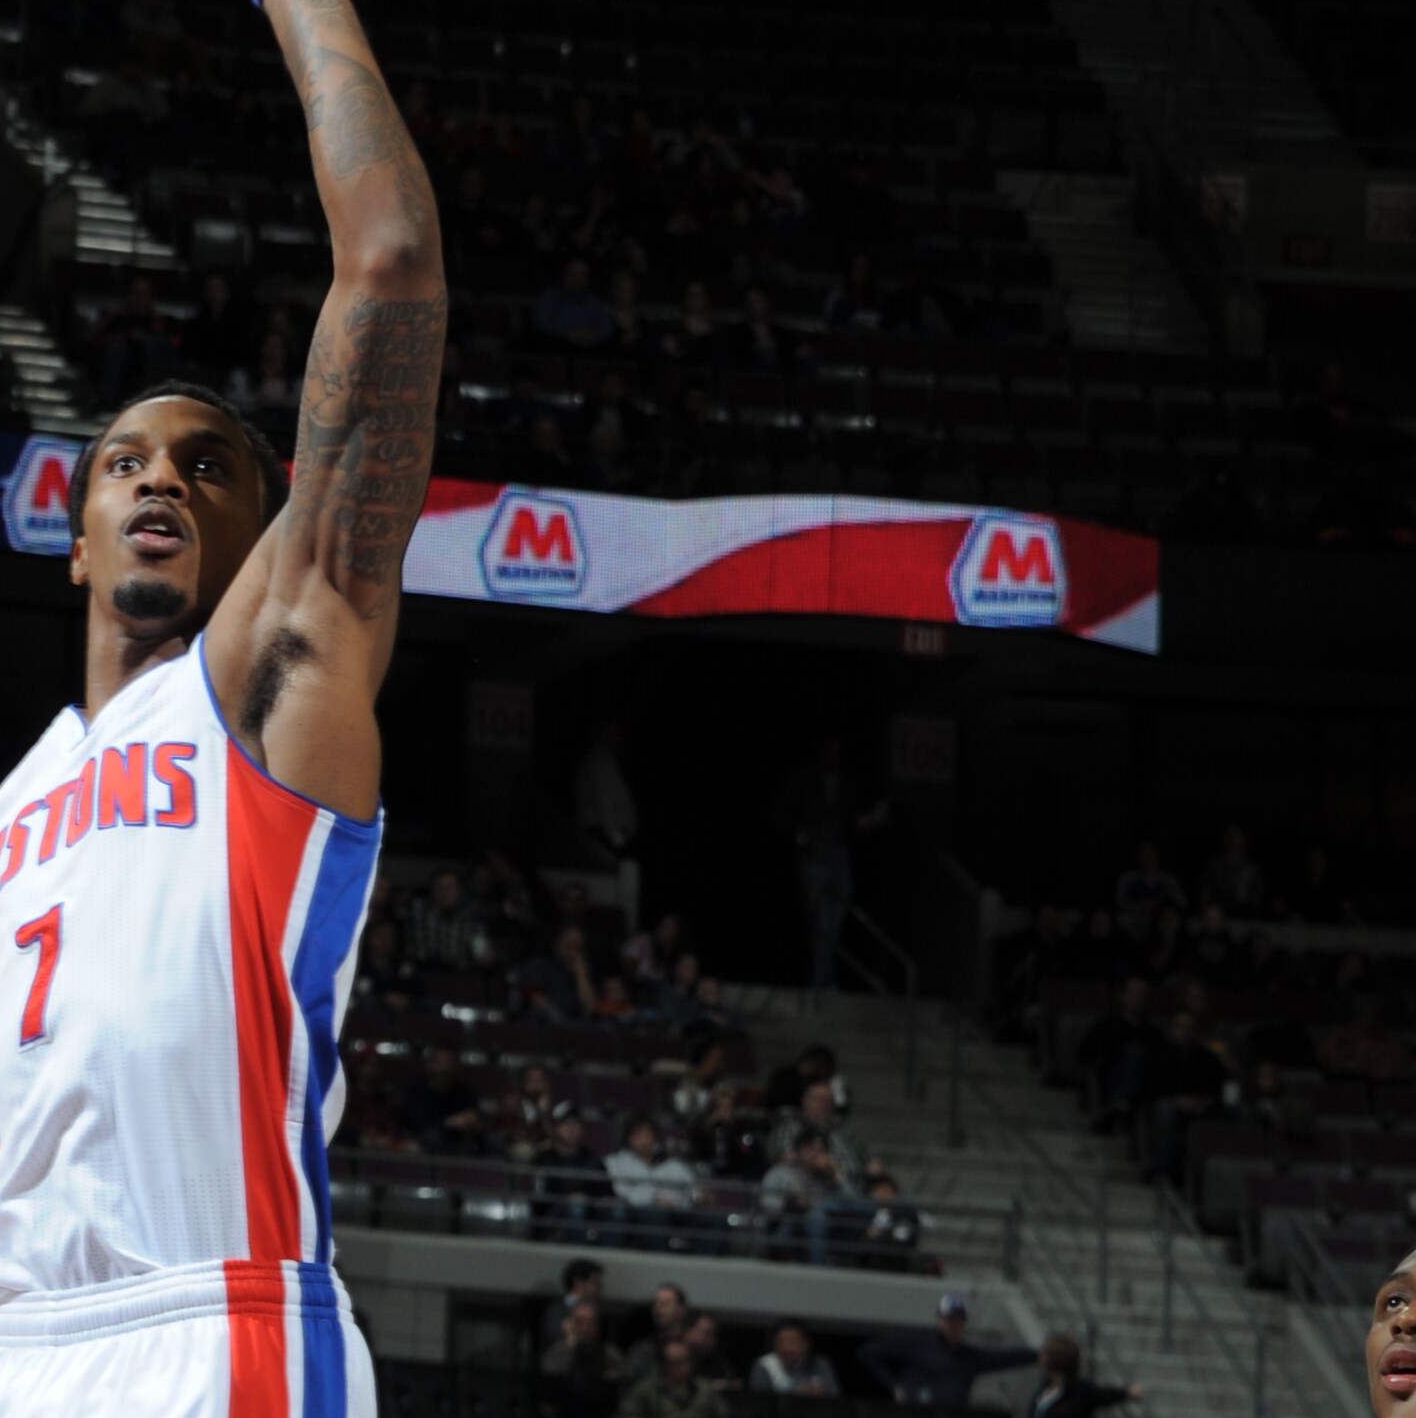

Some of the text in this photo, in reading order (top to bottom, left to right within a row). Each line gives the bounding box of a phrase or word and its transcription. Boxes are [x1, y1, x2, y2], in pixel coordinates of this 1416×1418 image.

[503, 507, 573, 562] M
[980, 530, 1054, 584] M
[15, 902, 64, 1047] 7
